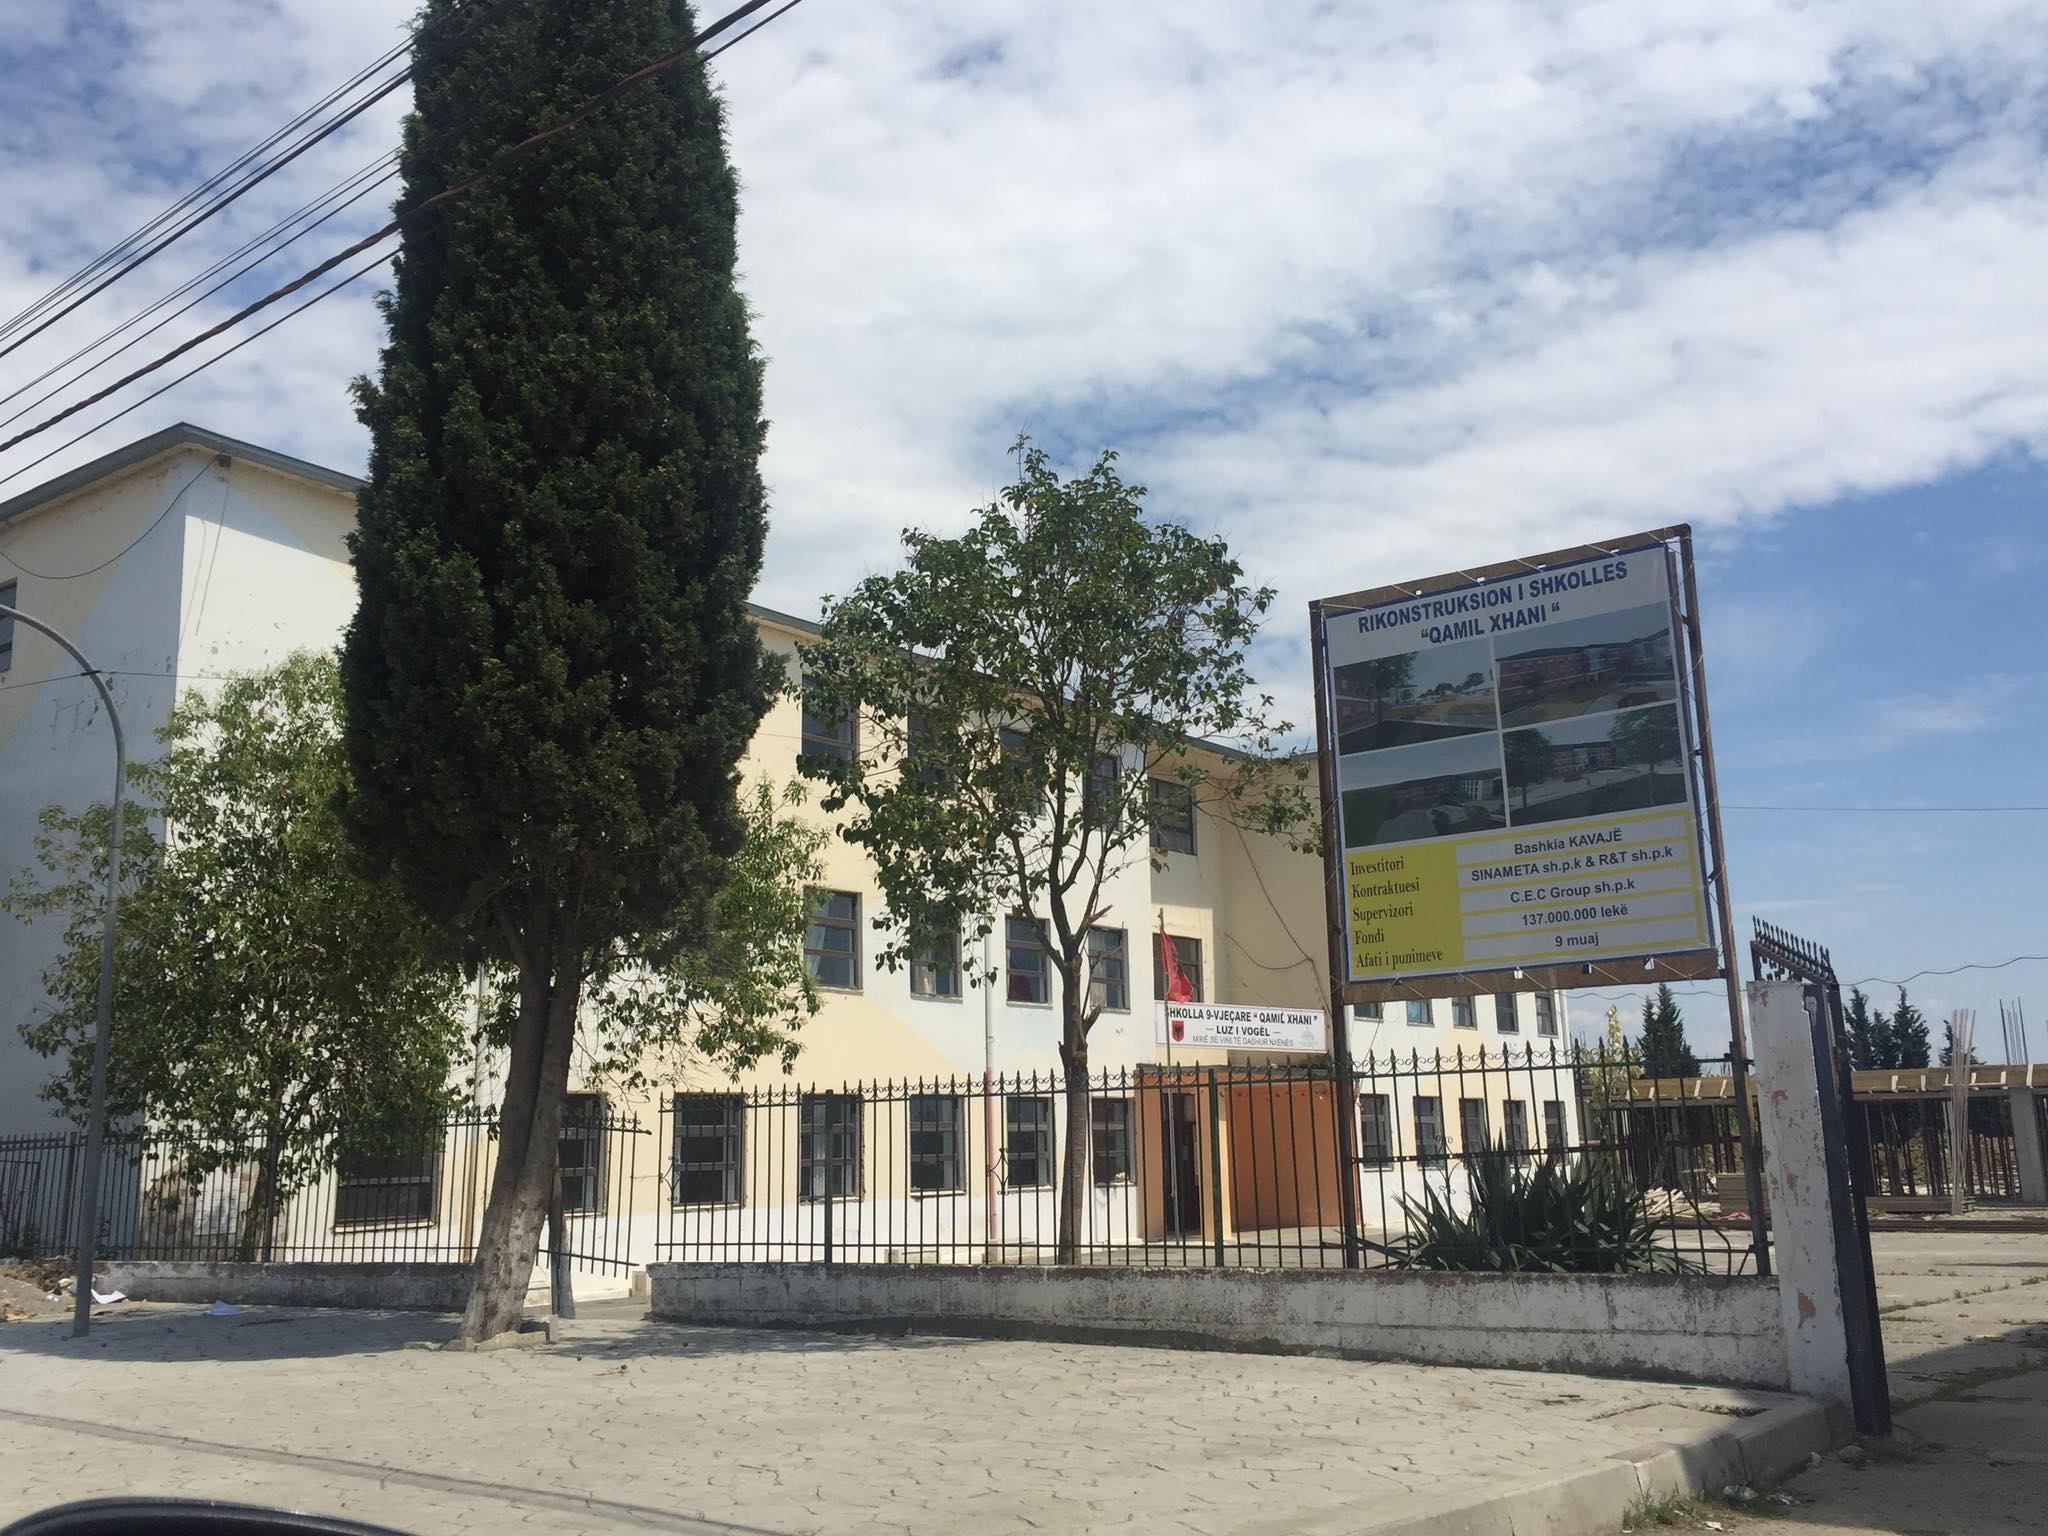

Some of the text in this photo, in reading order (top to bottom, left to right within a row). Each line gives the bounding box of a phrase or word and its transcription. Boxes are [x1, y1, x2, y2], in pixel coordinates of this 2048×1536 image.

[1358, 561, 1628, 634] RIKONSTRUKSION I SHKOLLES
[1490, 605, 1547, 632] XHANI
[1514, 828, 1623, 855] Bashkia KAVAJË
[1350, 856, 1404, 876] Investitori
[1471, 863, 1539, 882] SINAMETA
[1543, 856, 1581, 875] sh.p.k
[1599, 851, 1627, 866] R&T
[1631, 845, 1673, 864] sh.p.k
[1352, 877, 1420, 899] Kontraktuesi
[1510, 878, 1636, 904] C.E.C Group sh.p.k
[1353, 901, 1414, 926] Supervizori
[1522, 903, 1629, 926] 137.000.000 lekë
[1355, 928, 1385, 945] Fondi
[1555, 932, 1600, 948] 9 muaj
[1357, 951, 1382, 968] Afati
[1392, 948, 1444, 971] punimeve
[1216, 1025, 1233, 1035] LUZ
[1287, 1014, 1312, 1026] XHANI
